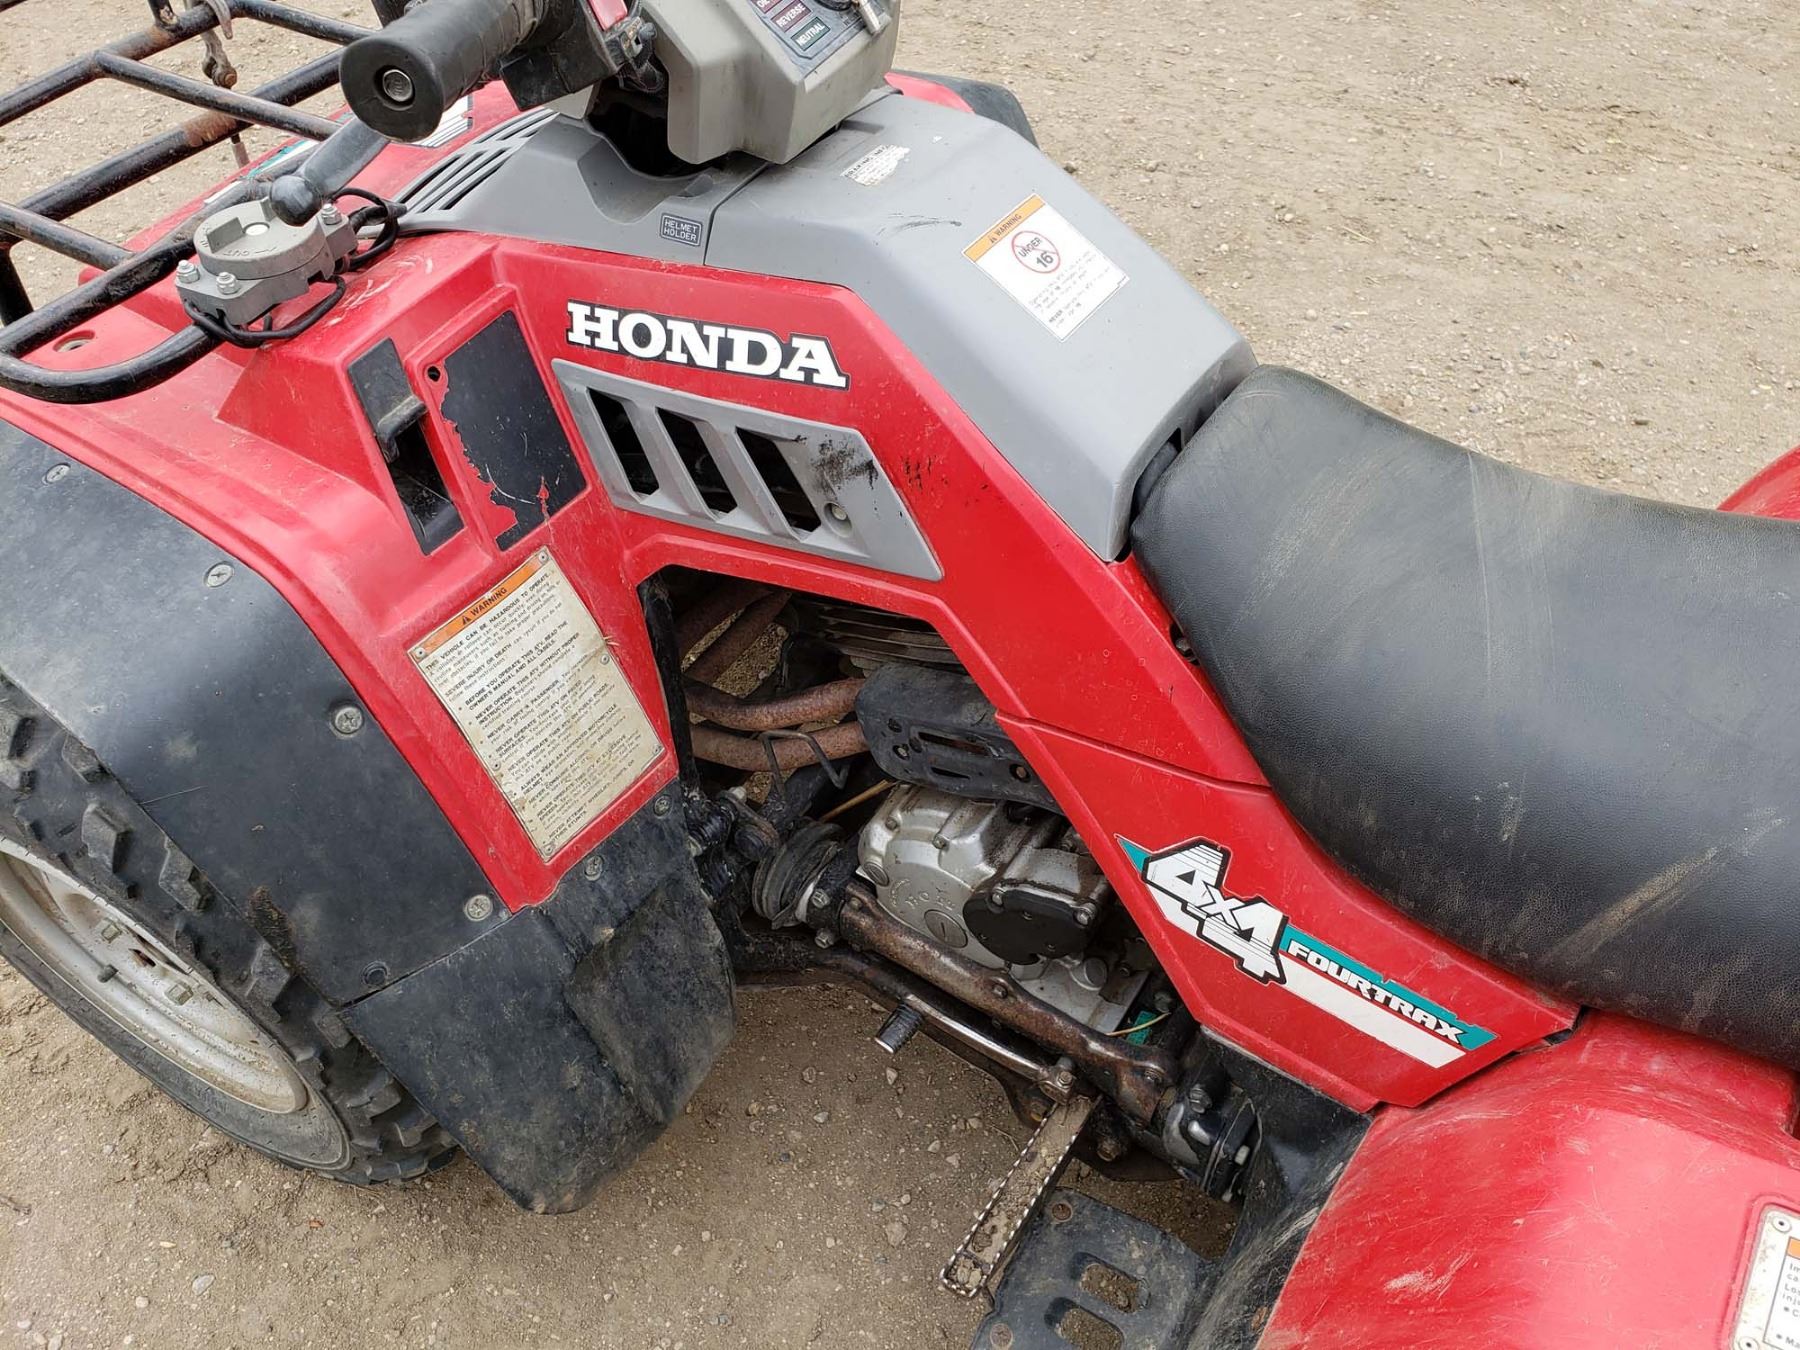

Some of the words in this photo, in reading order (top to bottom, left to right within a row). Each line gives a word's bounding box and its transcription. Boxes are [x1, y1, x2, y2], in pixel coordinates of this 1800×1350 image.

[776, 3, 807, 28] REVERSE
[795, 22, 826, 47] NEUTRAL
[663, 227, 697, 241] HOLDER
[664, 218, 698, 233] HELMET
[996, 213, 1023, 236] WARNING
[1018, 236, 1043, 258] UNDER
[1036, 251, 1054, 268] 16
[566, 300, 848, 389] HONDA
[470, 585, 507, 617] WARNING
[425, 658, 439, 671] THIS
[440, 639, 464, 660] VEHICLE
[464, 628, 478, 641] CAN
[478, 622, 487, 630] BE
[488, 596, 520, 624] HAZARDOUS
[520, 589, 528, 598] TO
[444, 678, 466, 697] SEVERE
[466, 663, 485, 680] INJURY
[485, 656, 494, 665] OR
[493, 642, 511, 658] DEATH
[464, 686, 486, 705] BEFORE
[485, 676, 498, 688] YOU
[497, 658, 521, 679] OPERATE
[520, 648, 533, 660] THIS
[543, 628, 558, 641] READ
[557, 619, 568, 630] THE
[492, 671, 515, 691] MANUAL
[514, 662, 526, 674] AND
[525, 654, 536, 664] ALL
[475, 703, 493, 720] NEVER
[492, 684, 516, 706] OPERATE
[516, 674, 529, 686] THIS
[528, 666, 539, 676] ATV
[538, 647, 562, 668] WITHOUT
[487, 722, 505, 739] NEVER
[505, 707, 523, 725] CARRY
[495, 736, 513, 753] NEVER
[513, 717, 536, 739] OPERATE
[537, 707, 549, 719] THIS
[507, 755, 525, 773] NEVER
[525, 736, 548, 758] OPERATE
[548, 726, 560, 738] THIS
[520, 771, 540, 791] ALWAYS
[540, 758, 555, 773] WEAR
[555, 751, 563, 760] AN
[562, 729, 588, 753] APPROVED
[528, 787, 545, 804] NEVER
[536, 800, 553, 817] NEVER
[548, 821, 565, 839] NEVER
[1288, 940, 1465, 1044] FOURTRAX
